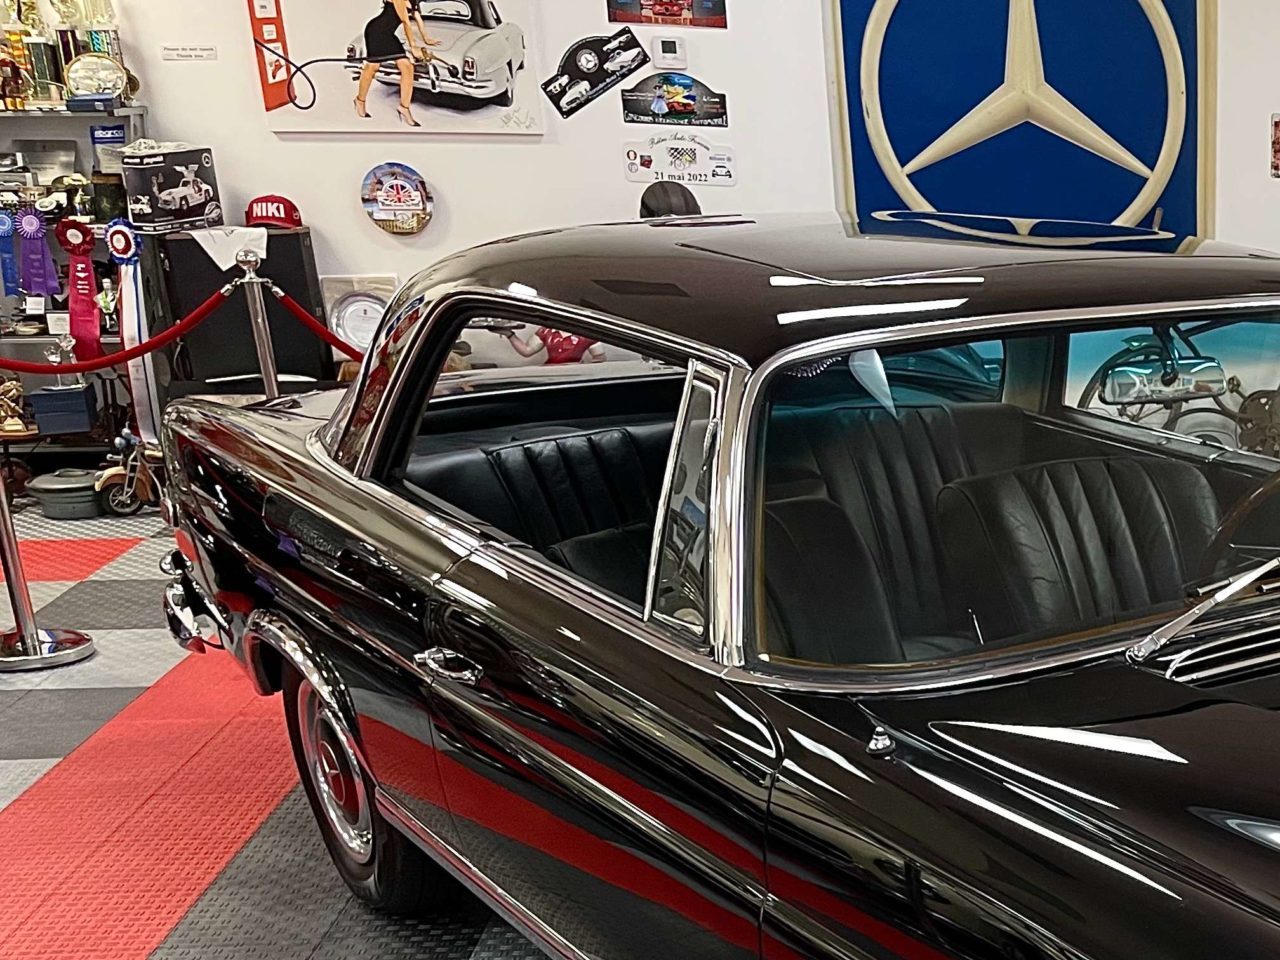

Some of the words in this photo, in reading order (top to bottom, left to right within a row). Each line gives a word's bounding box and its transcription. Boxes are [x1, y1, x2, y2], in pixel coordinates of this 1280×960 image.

[654, 171, 664, 180] 21
[668, 172, 685, 182] mai
[687, 172, 708, 182] 2022
[252, 201, 286, 218] NIKI
